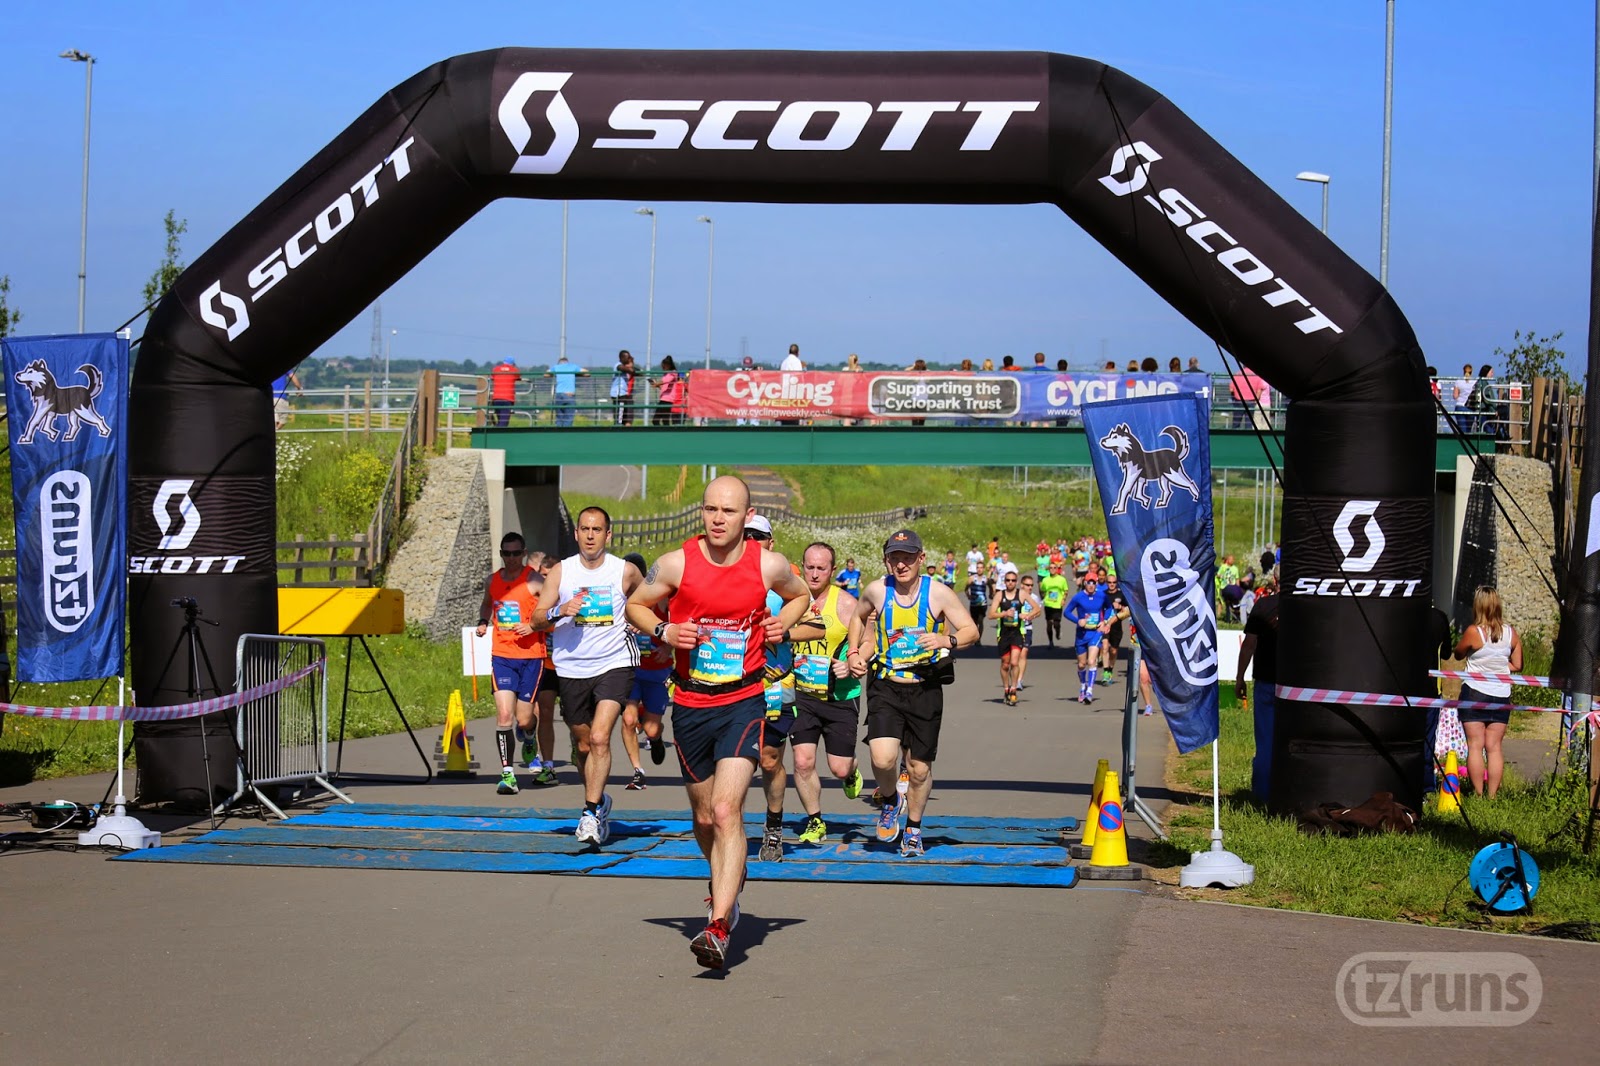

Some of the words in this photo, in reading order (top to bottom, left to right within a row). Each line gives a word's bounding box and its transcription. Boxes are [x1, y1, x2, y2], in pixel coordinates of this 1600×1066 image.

[593, 100, 1040, 150] SCOTT
[248, 136, 415, 302] SCOTT
[1144, 188, 1344, 335] SCOTT
[726, 373, 836, 407] Cycling
[886, 382, 973, 397] Supporting
[975, 382, 1001, 395] the
[757, 399, 812, 408] WEEKLY
[884, 397, 962, 411] Cyclopark
[964, 398, 1002, 410] Trust
[129, 556, 246, 574] SCOTT
[1292, 577, 1422, 597] SCOTT
[704, 662, 726, 670] MARK
